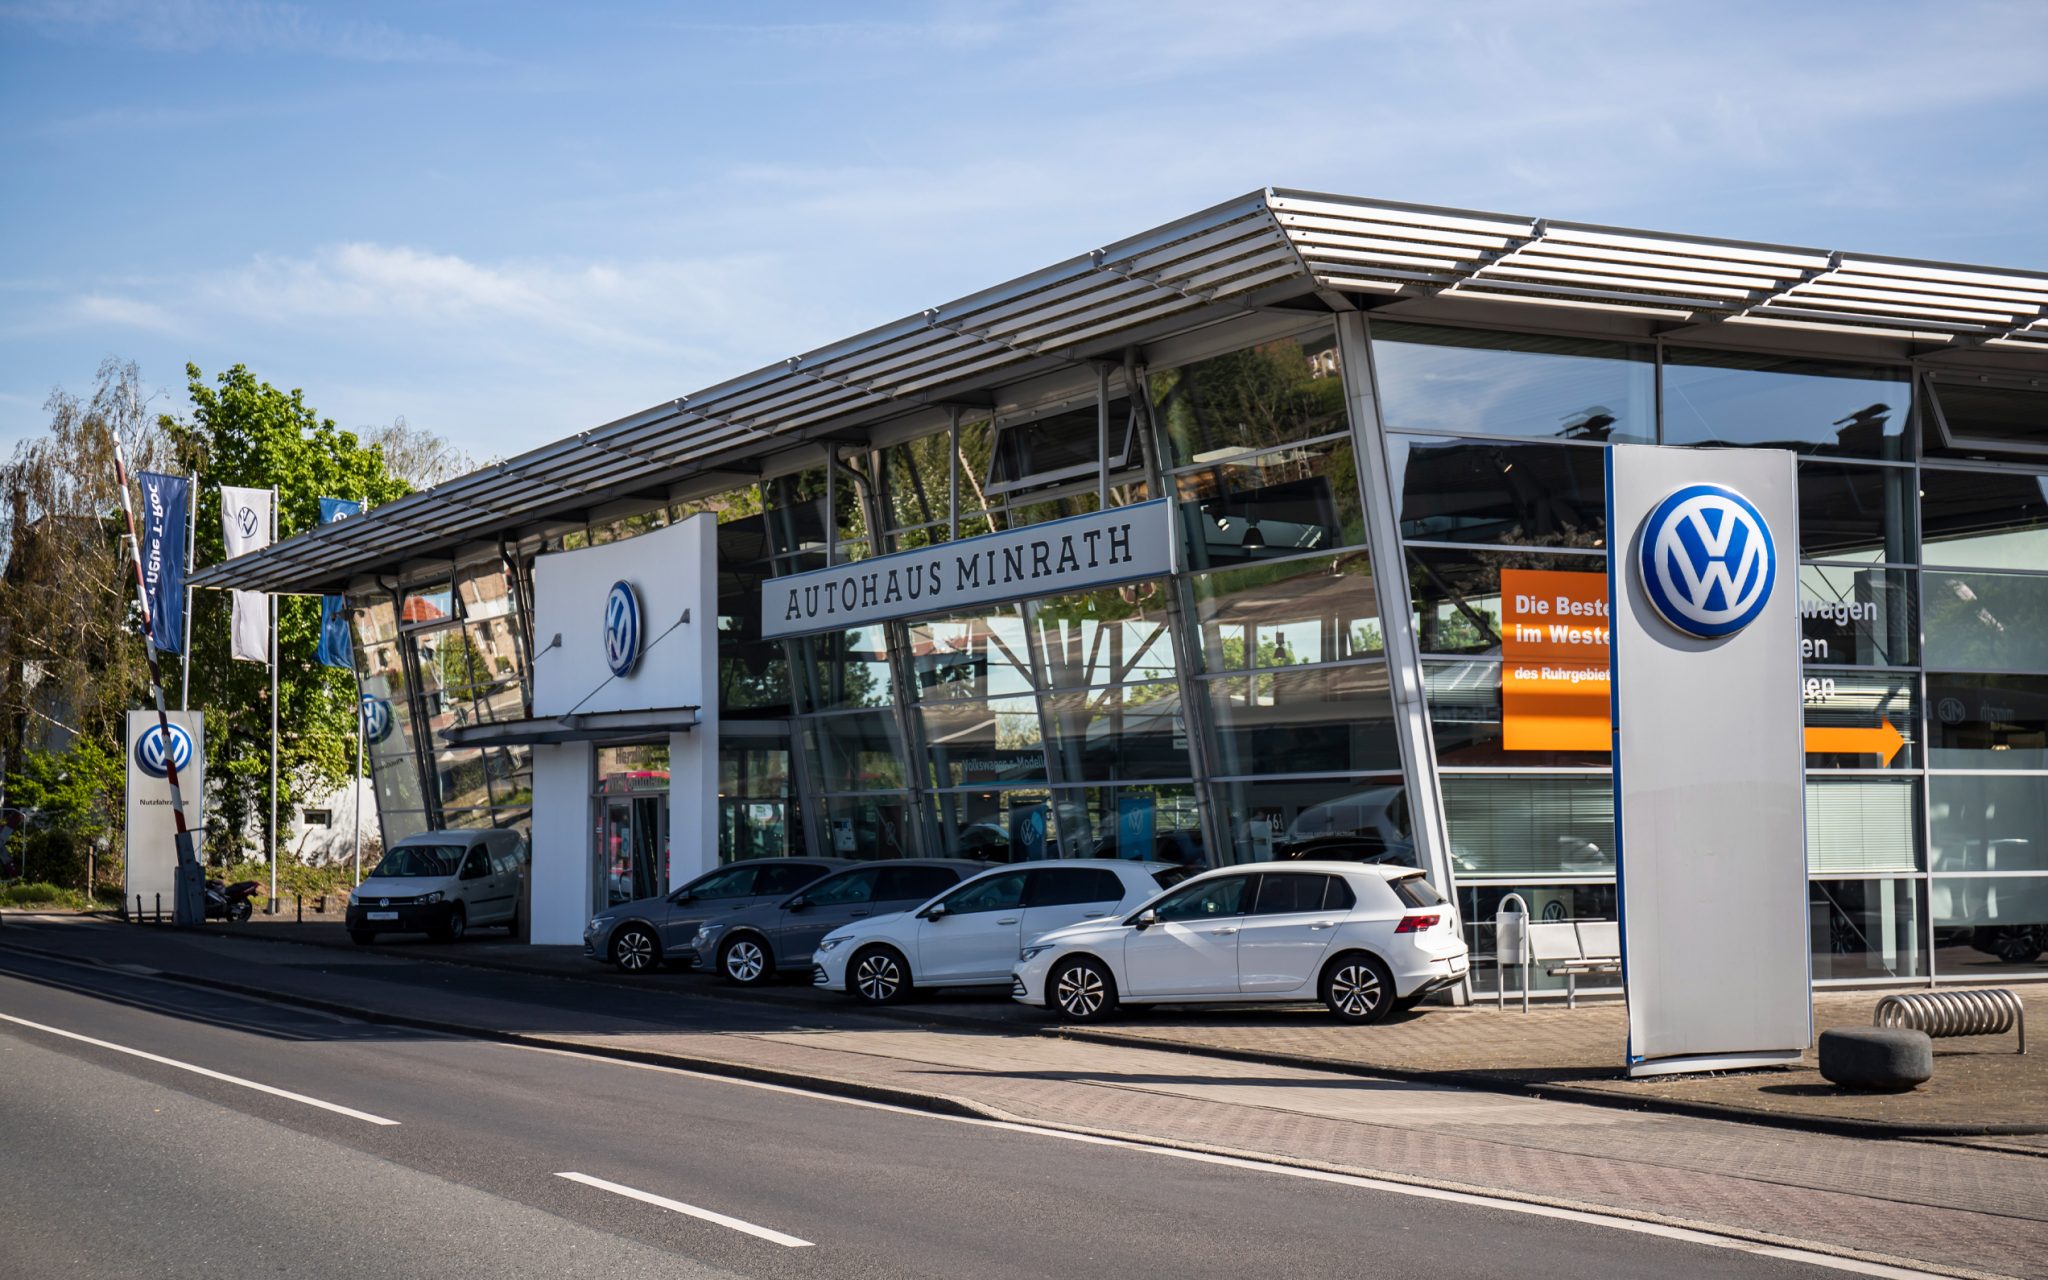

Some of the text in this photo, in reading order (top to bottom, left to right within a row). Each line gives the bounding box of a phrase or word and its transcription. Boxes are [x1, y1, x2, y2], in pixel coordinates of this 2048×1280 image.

[785, 523, 1132, 621] AUTOHAUS MINRATH
[1515, 595, 1609, 617] Die Beste
[1800, 600, 1878, 626] wagen
[1515, 623, 1610, 645] im Weste
[1800, 637, 1829, 659] en
[1514, 667, 1611, 684] des Ruhrgebiet
[1802, 677, 1836, 698] en
[139, 799, 190, 807] Nutzfahrzge
